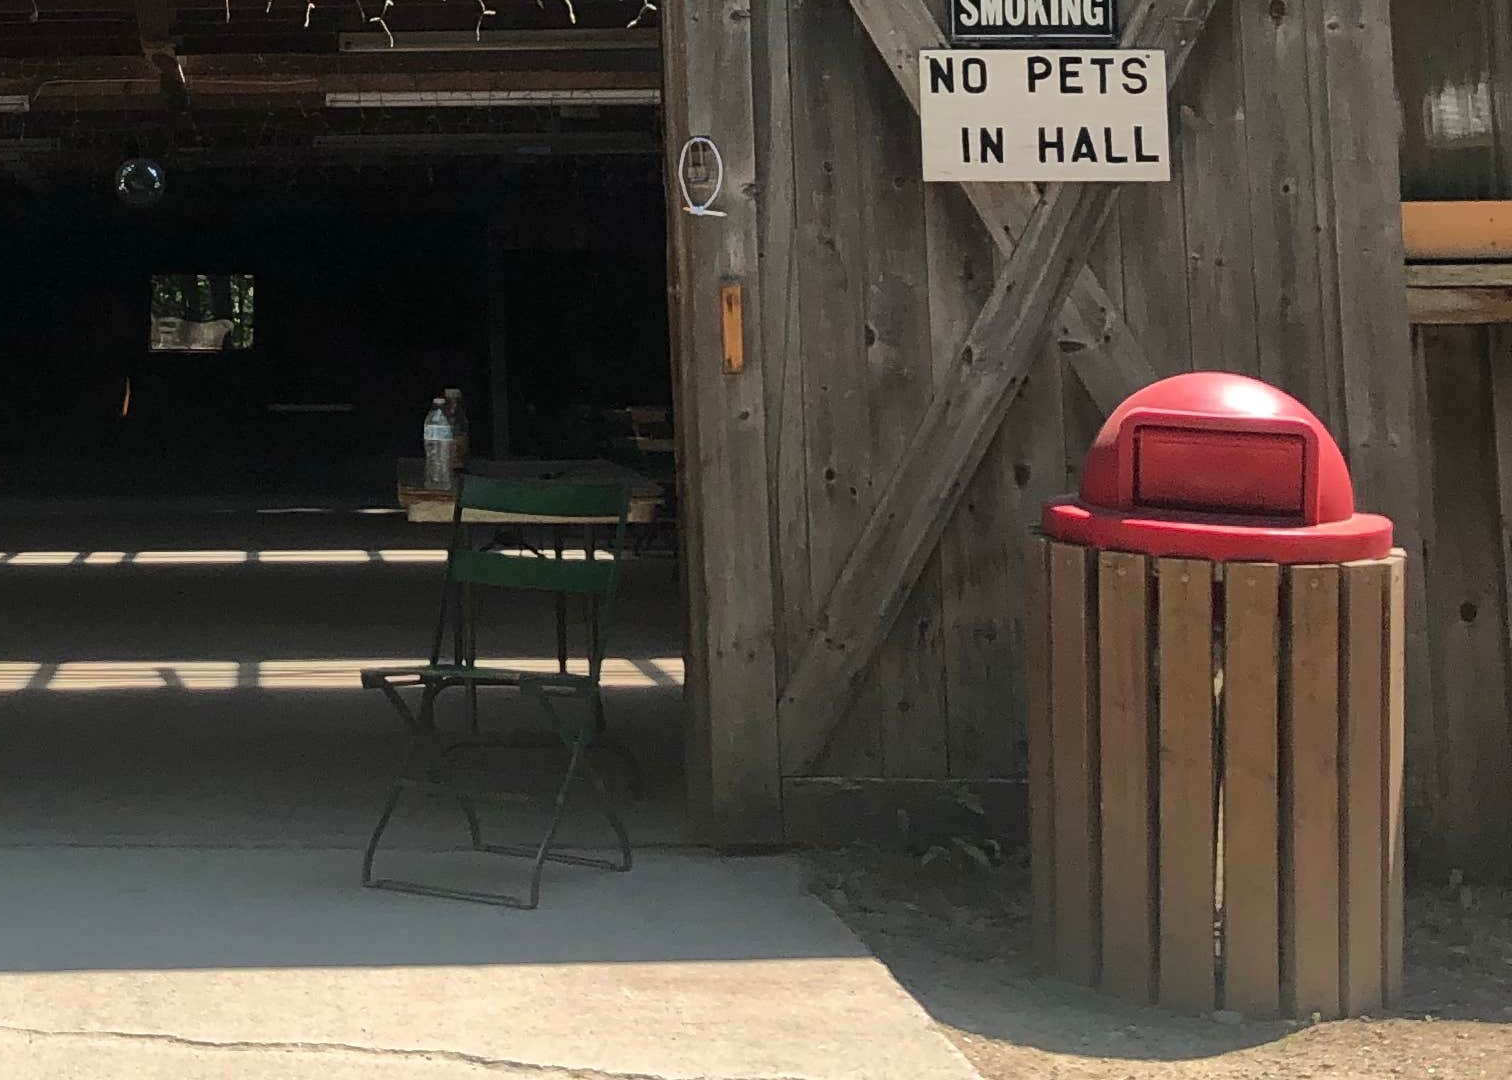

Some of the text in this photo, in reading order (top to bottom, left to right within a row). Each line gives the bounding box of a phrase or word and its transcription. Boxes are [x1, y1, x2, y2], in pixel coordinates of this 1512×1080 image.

[929, 56, 1148, 94] NO PETS
[961, 126, 1160, 163] IN HALL
